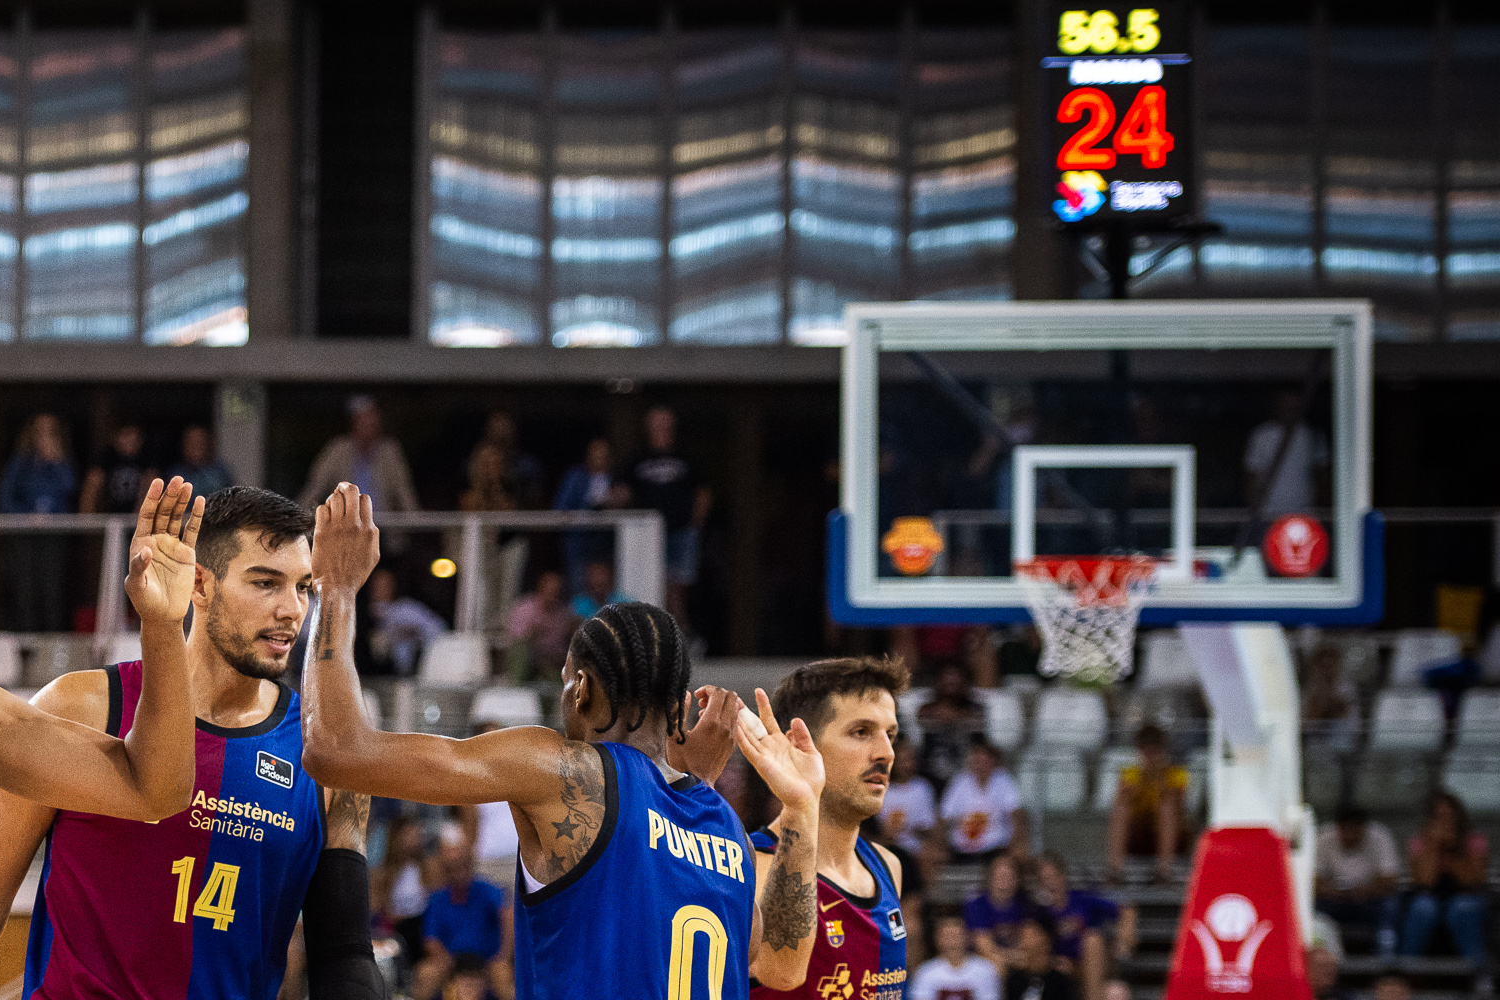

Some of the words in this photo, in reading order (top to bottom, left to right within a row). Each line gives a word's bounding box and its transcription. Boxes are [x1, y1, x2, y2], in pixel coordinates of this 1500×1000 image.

[1057, 9, 1161, 54] 56.5
[1056, 85, 1175, 170] 24
[259, 768, 290, 784] endesa
[189, 809, 264, 842] Sanitària
[192, 790, 295, 832] Assistència
[647, 808, 745, 883] PUNTER
[171, 855, 241, 932] 14
